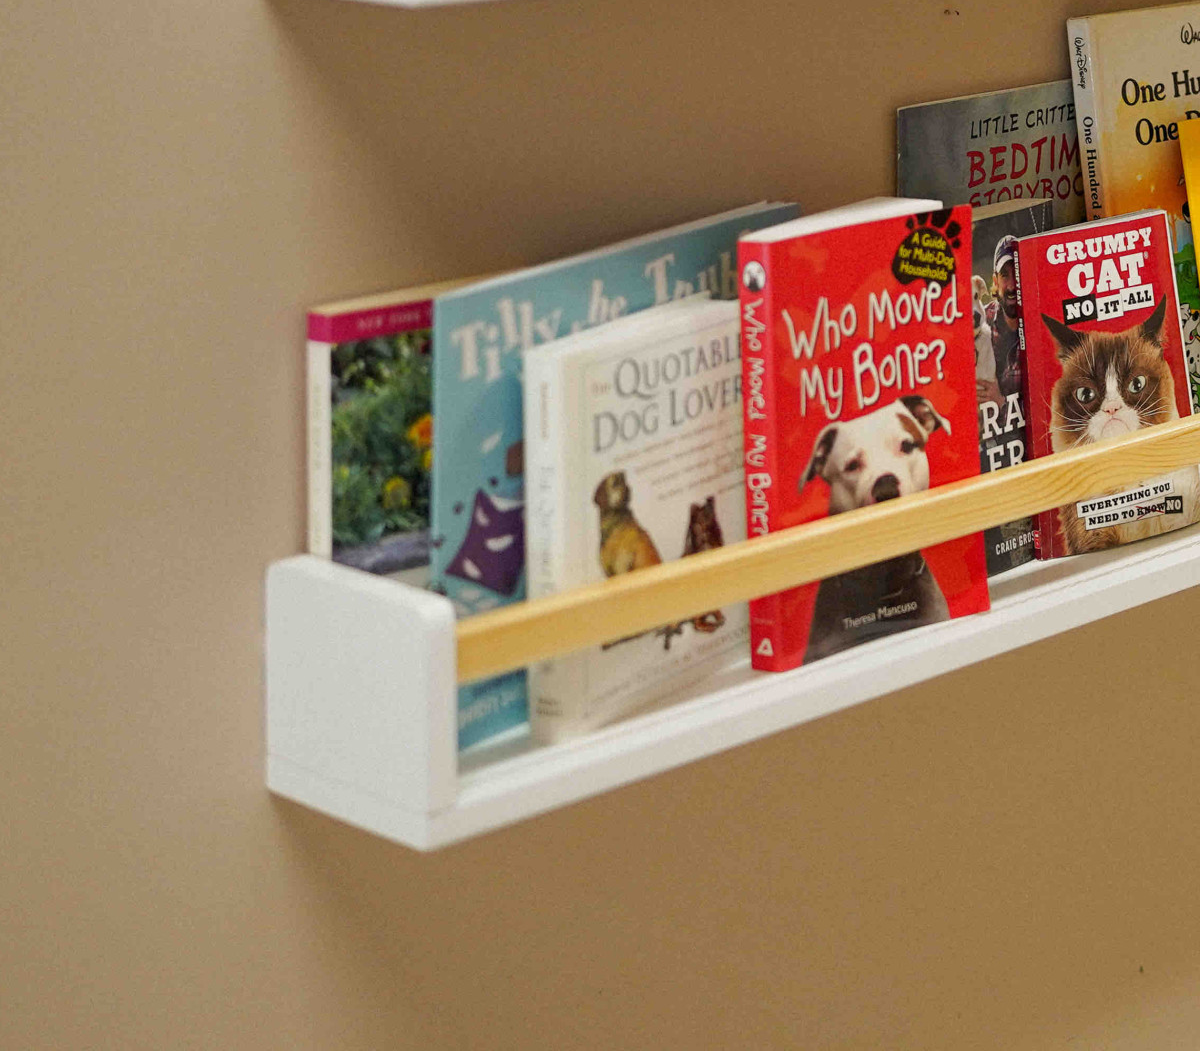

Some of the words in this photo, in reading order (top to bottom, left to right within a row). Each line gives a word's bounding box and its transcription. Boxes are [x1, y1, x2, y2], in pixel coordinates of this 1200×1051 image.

[1121, 78, 1166, 107] One
[970, 113, 1019, 139] LITTLE
[1082, 116, 1092, 144] One
[1135, 117, 1179, 146] One
[1086, 149, 1102, 210] Hundred
[911, 231, 920, 244] A
[921, 233, 947, 249] Guide
[1046, 227, 1153, 267] GRUMPY
[899, 246, 912, 260] for
[912, 249, 954, 270] Multi-Dog
[900, 262, 949, 281] Households
[1066, 252, 1146, 298] CAT
[743, 298, 767, 351] Who
[782, 296, 857, 360] Who
[868, 274, 964, 340] Moved
[452, 298, 562, 382] Tilly
[746, 356, 767, 421] Moved
[801, 364, 844, 420] My
[852, 339, 946, 410] Bone?
[593, 402, 659, 452] DOG
[747, 434, 766, 468] My
[1081, 488, 1150, 514] EVERYTHING
[1152, 482, 1171, 496] YOU
[1088, 512, 1119, 527] NEED
[1121, 509, 1136, 524] TO
[1166, 498, 1182, 512] NO
[995, 536, 1017, 556] CRAIG
[843, 611, 876, 630] Theresa
[877, 600, 918, 620] Mancuso
